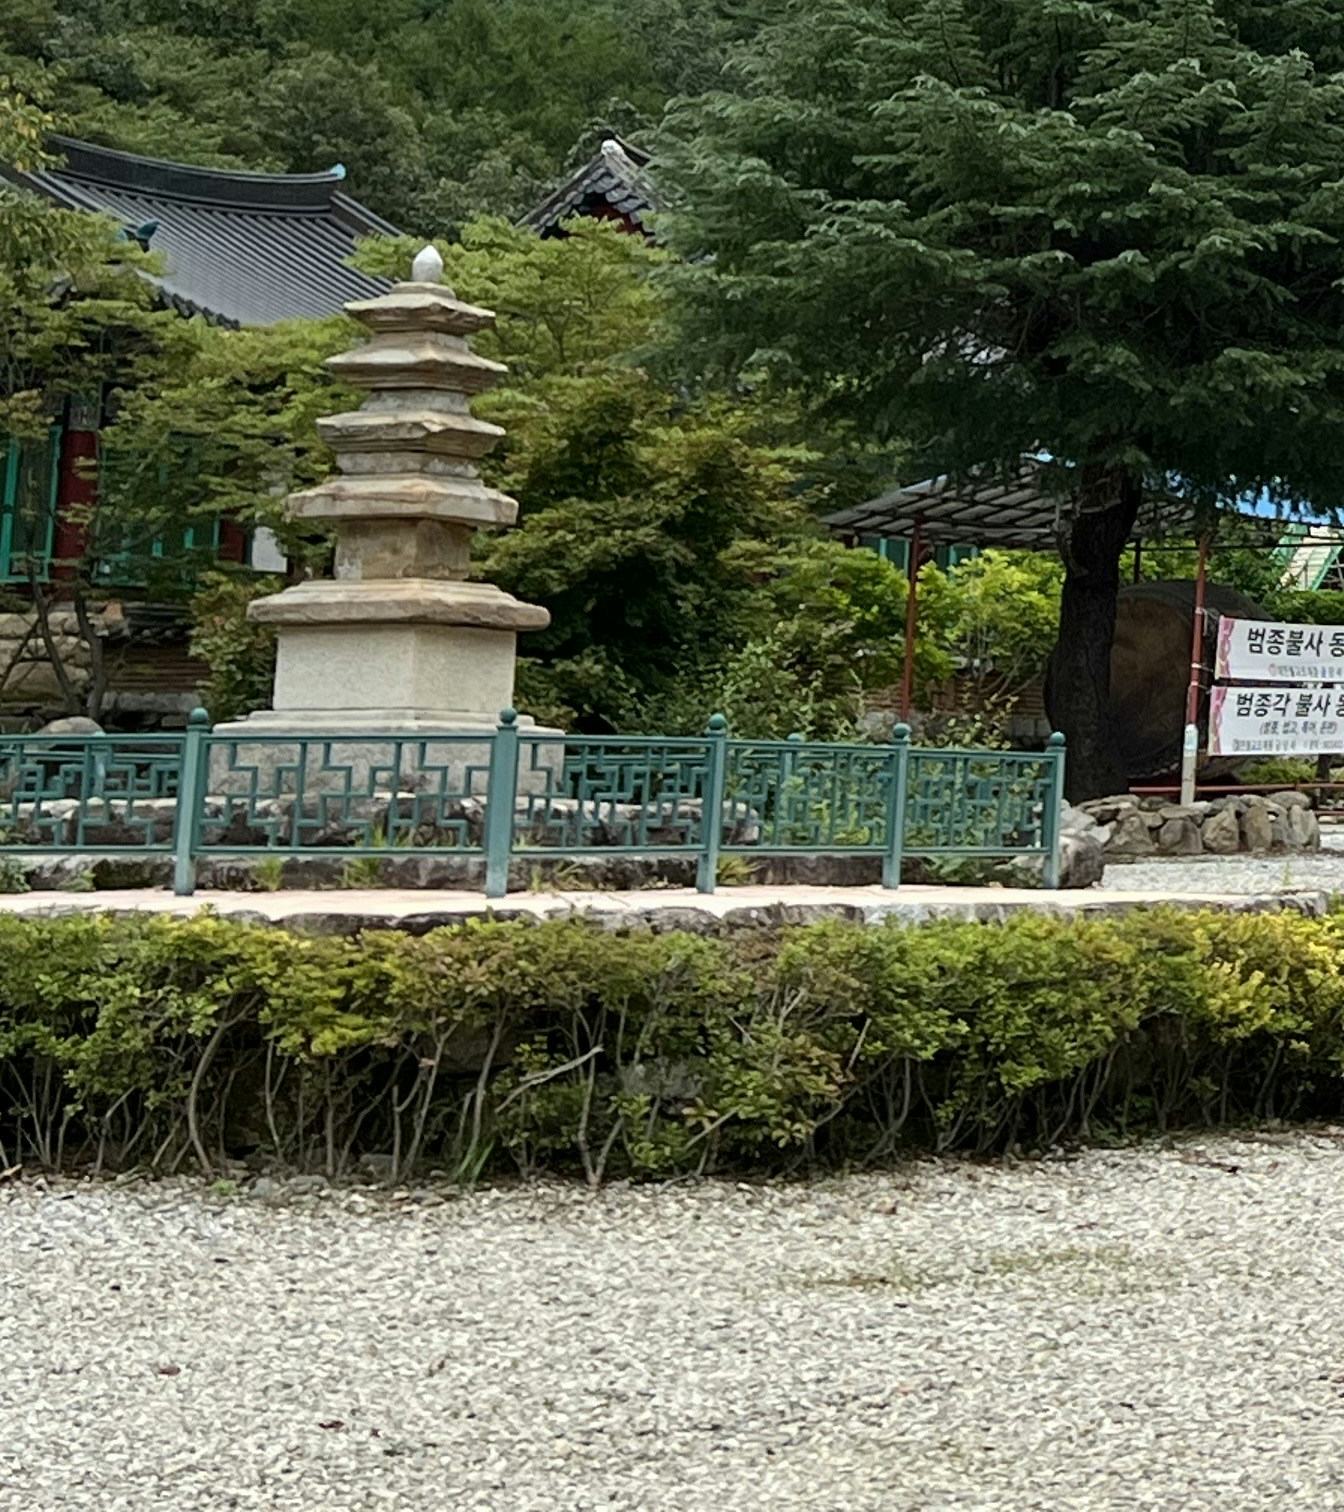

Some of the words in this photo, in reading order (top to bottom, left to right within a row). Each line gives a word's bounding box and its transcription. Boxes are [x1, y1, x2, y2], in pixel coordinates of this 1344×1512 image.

[1247, 627, 1323, 657] 범종불사
[1236, 693, 1291, 718] 범종각
[1295, 693, 1331, 718] 불사
